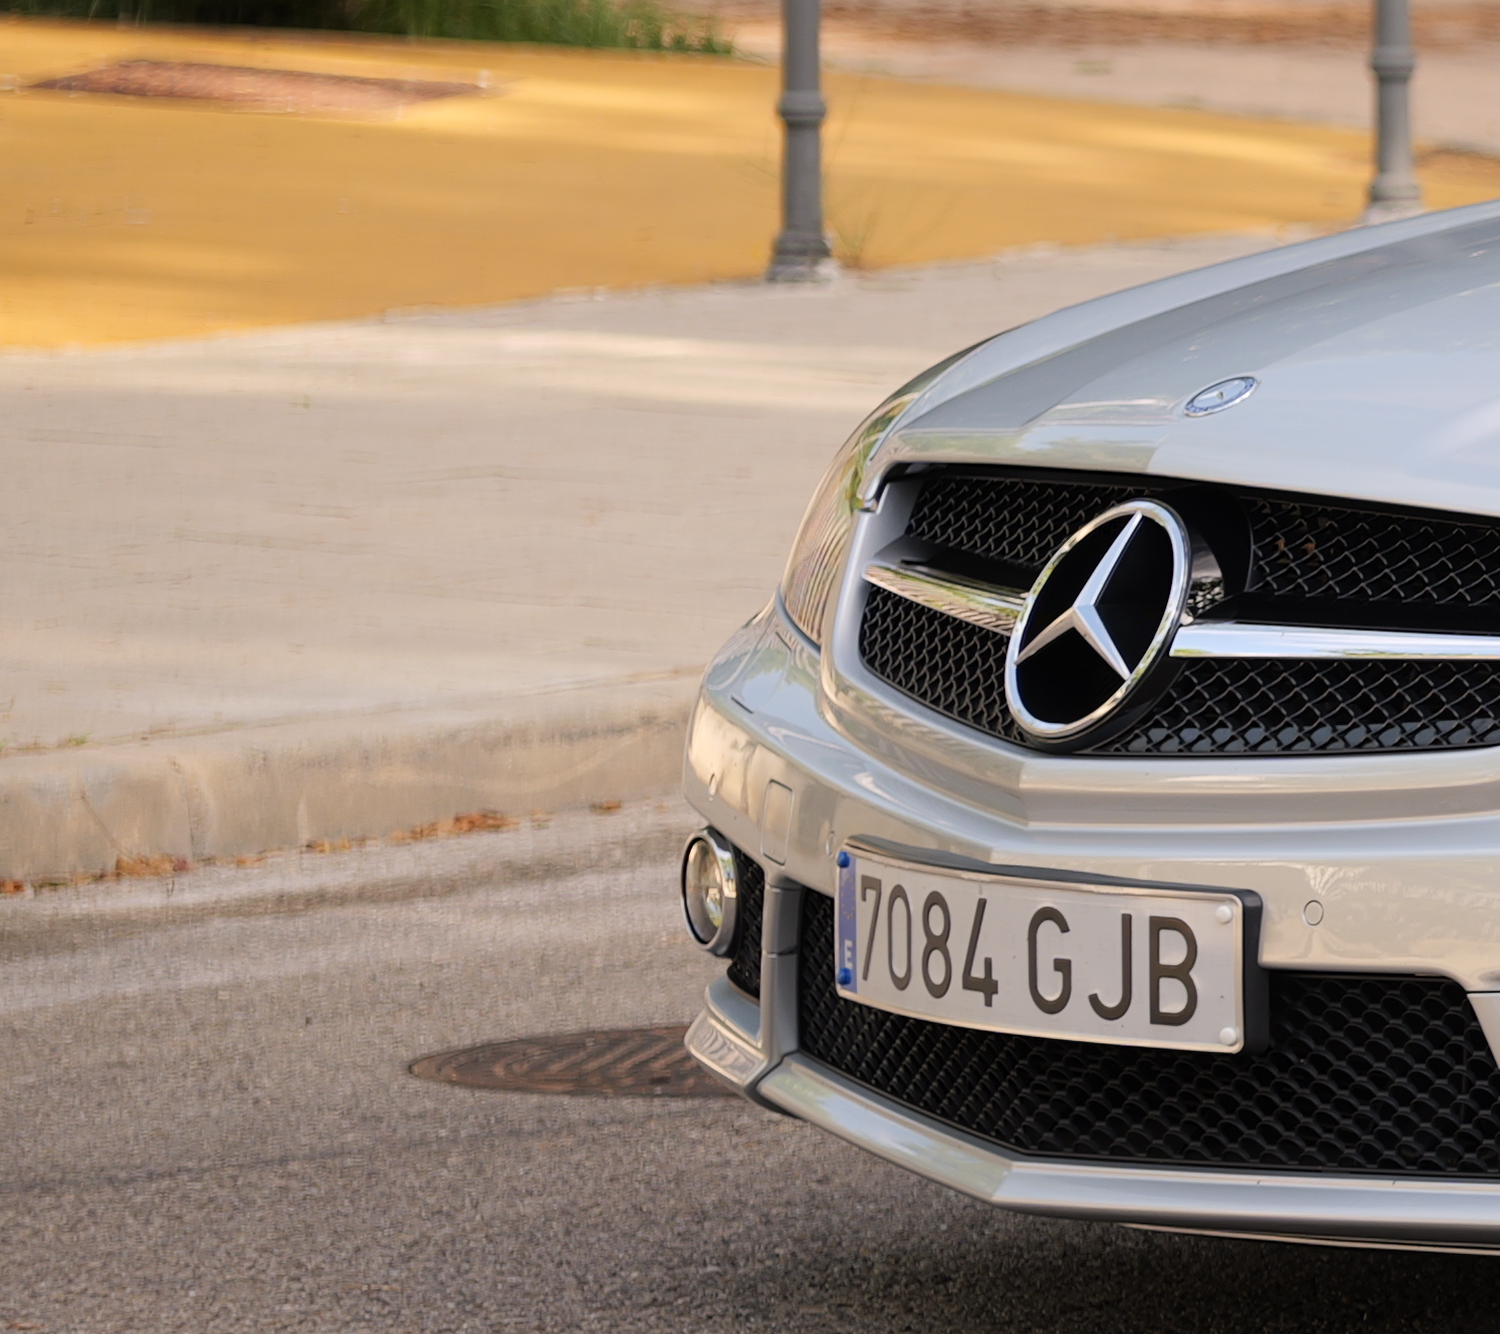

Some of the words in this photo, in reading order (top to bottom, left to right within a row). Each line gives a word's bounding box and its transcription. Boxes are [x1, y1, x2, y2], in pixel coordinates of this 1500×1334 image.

[844, 938, 854, 970] E
[860, 873, 999, 1008] 7084
[1027, 905, 1199, 1027] GJB
